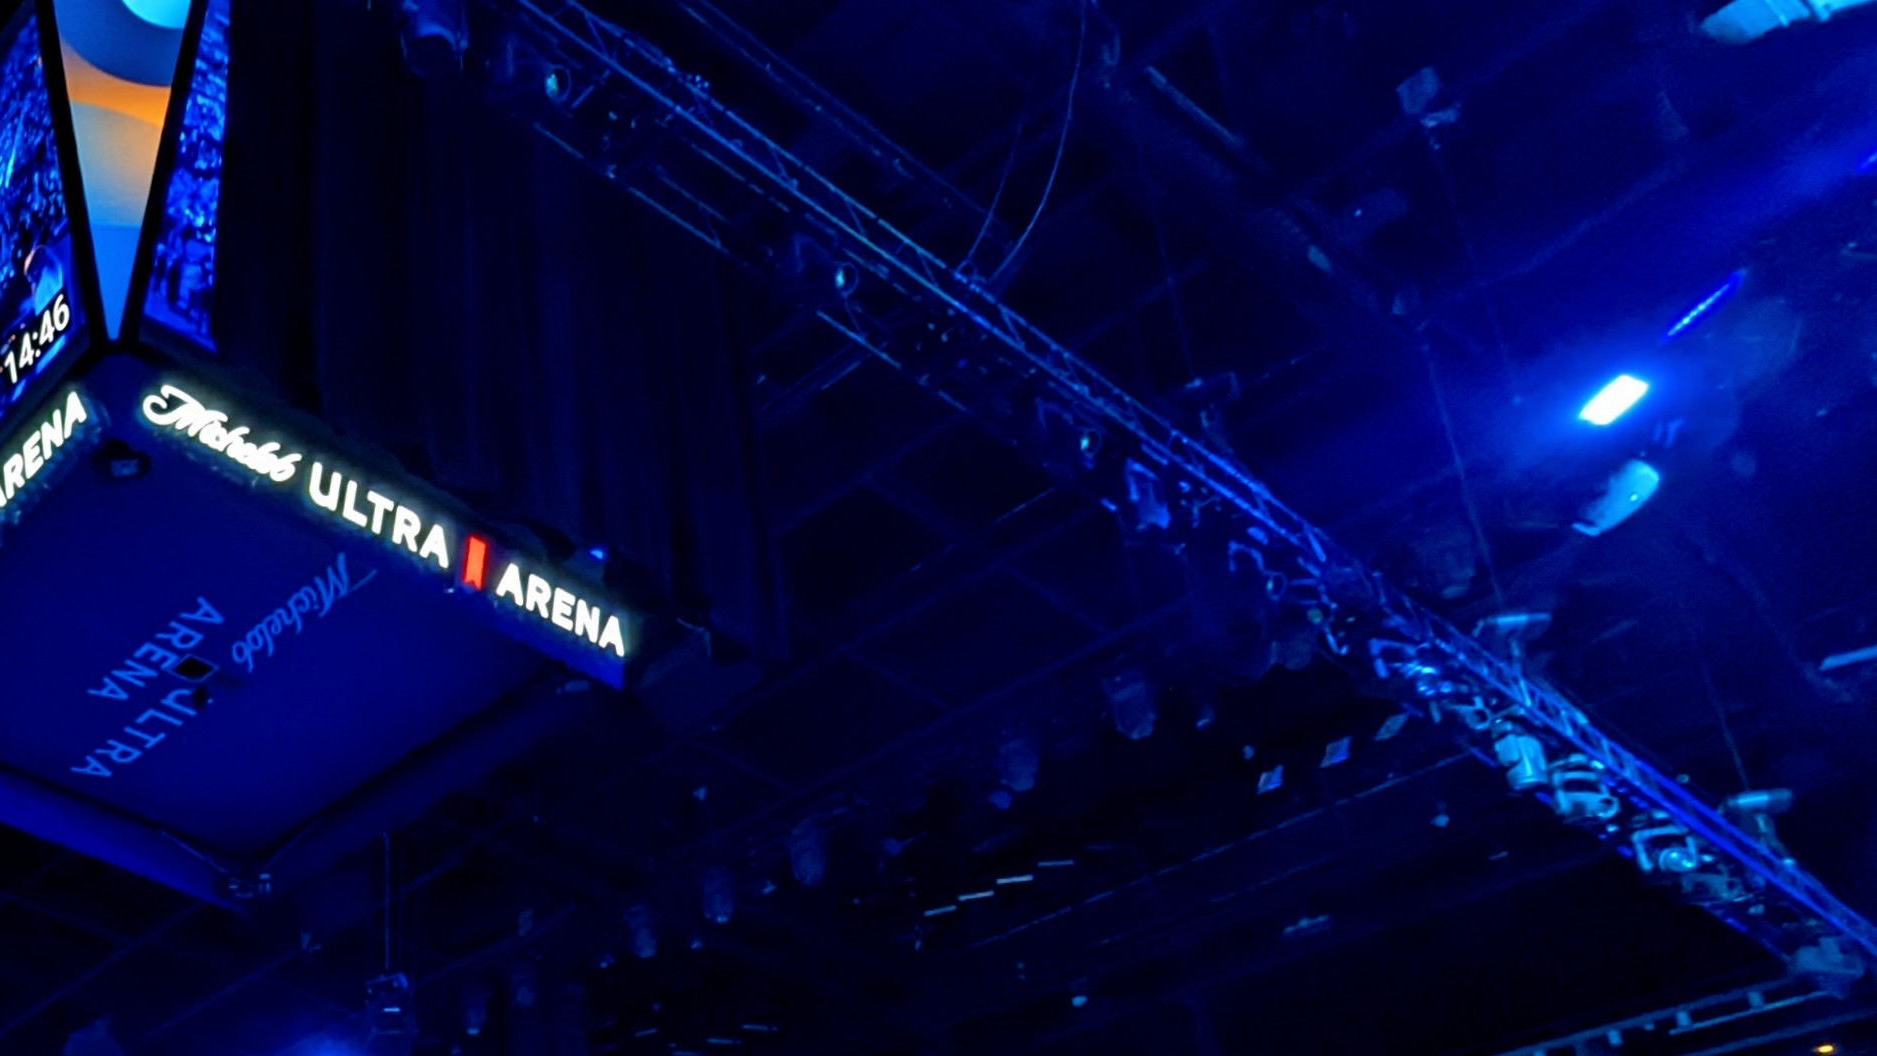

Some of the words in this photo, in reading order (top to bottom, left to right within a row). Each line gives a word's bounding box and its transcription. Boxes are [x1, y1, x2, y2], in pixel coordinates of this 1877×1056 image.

[3, 293, 70, 384] 14:46
[142, 384, 302, 482] Michelob
[308, 462, 450, 569] ULTRA
[496, 563, 626, 657] ARENA
[87, 596, 224, 701] ARENA
[231, 552, 377, 673] Michelob
[70, 688, 198, 778] ULTRA
